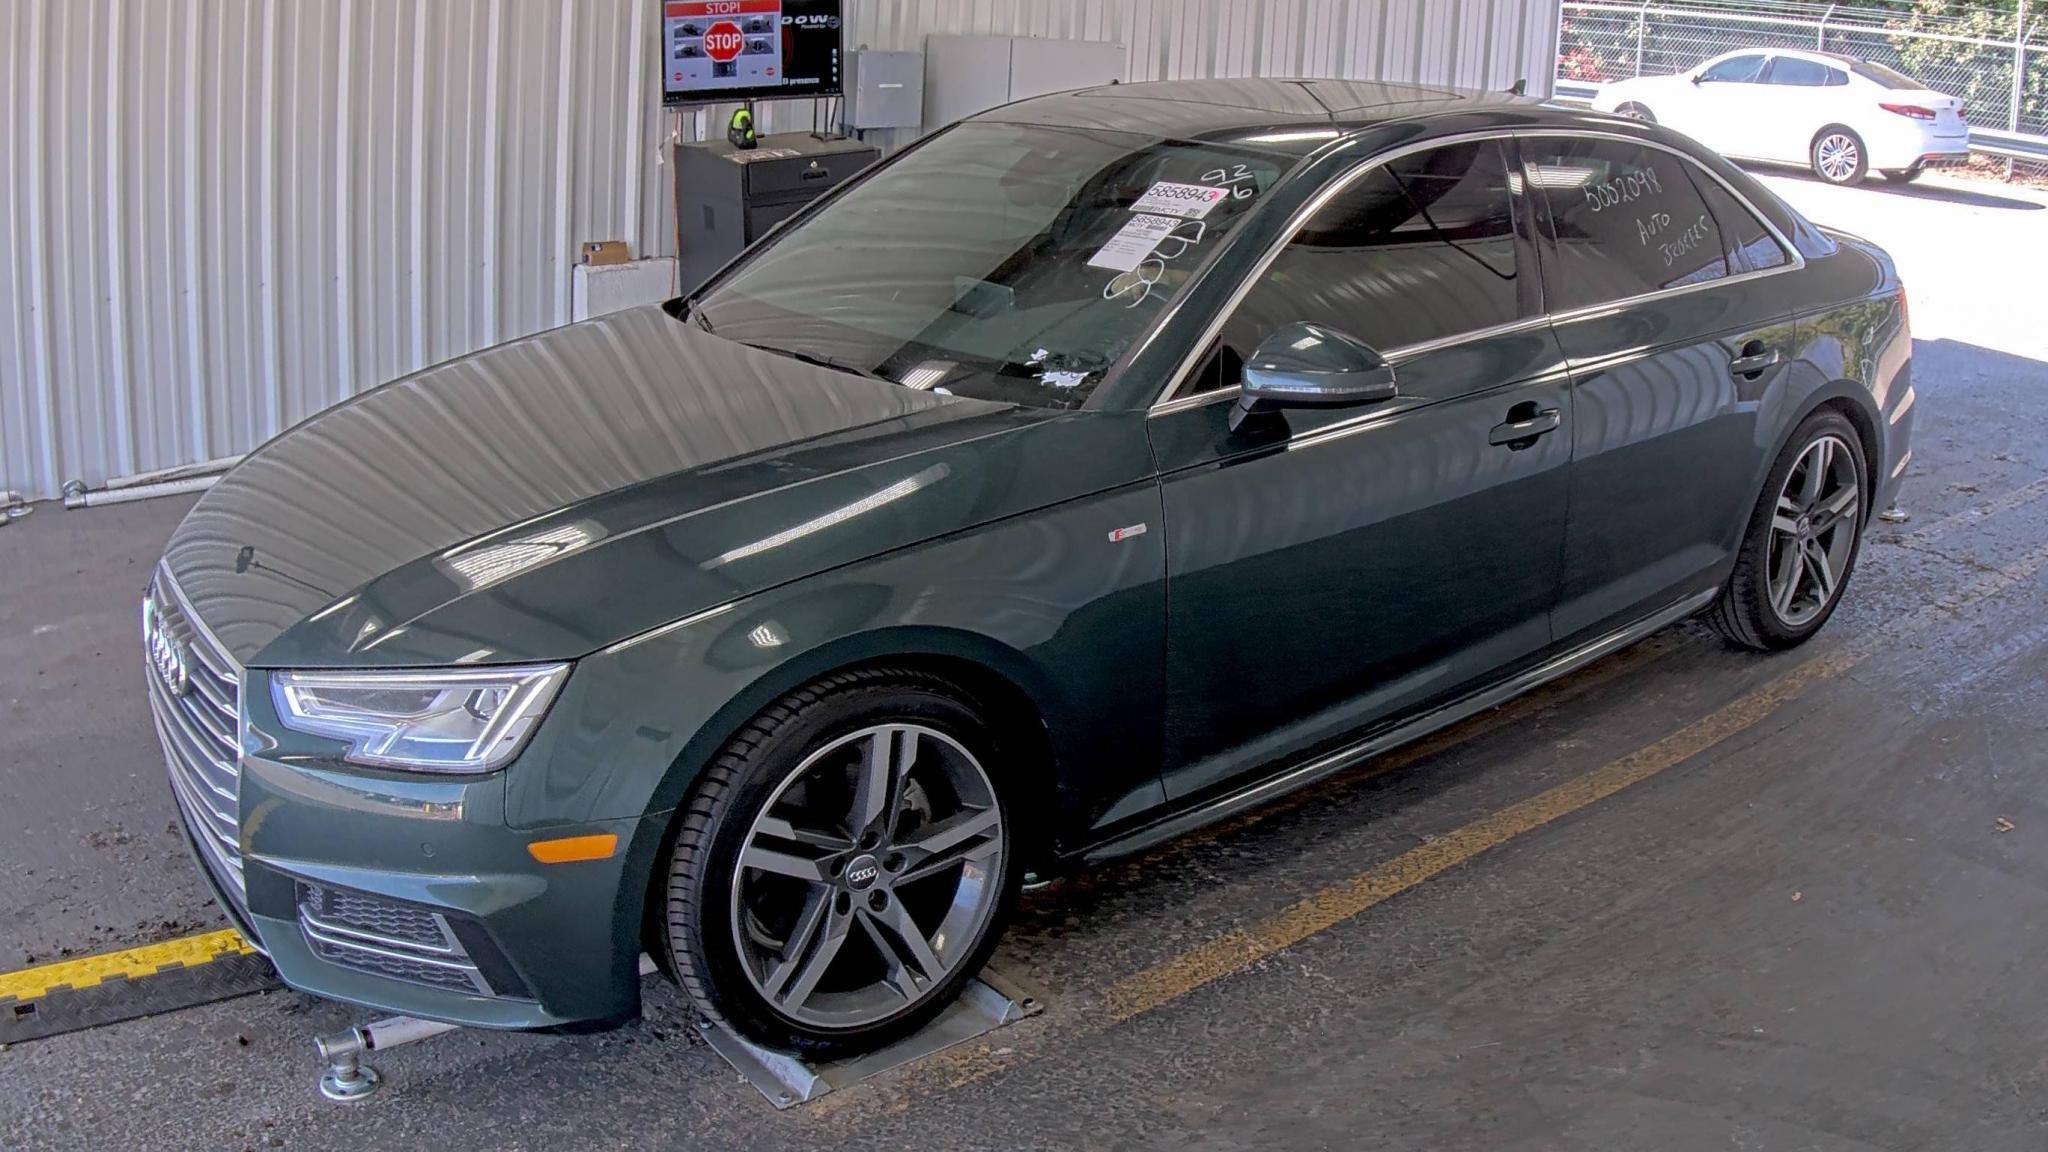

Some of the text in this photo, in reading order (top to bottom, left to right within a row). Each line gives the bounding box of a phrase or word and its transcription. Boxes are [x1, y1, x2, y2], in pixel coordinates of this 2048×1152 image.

[706, 1, 741, 15] STOP!
[706, 32, 741, 50] STOP
[1148, 184, 1217, 203] 5858943
[1131, 214, 1179, 228] 5858943
